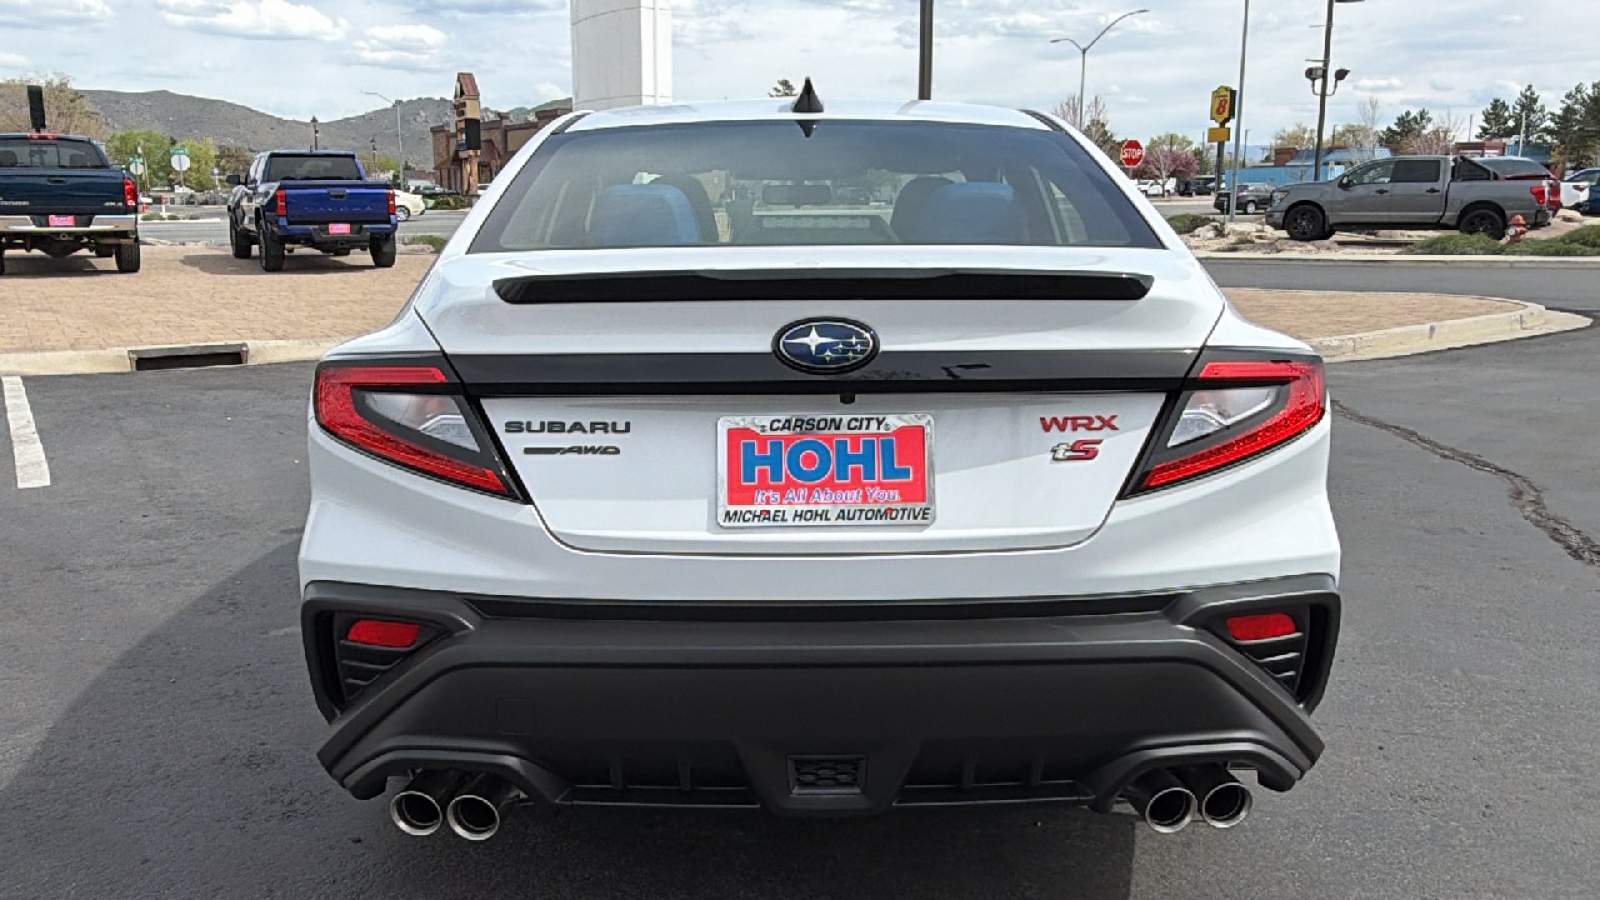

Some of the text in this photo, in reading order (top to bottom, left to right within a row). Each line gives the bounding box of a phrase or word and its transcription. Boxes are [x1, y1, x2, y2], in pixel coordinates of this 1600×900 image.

[1122, 148, 1143, 160] STOP
[504, 421, 631, 434] SUBARU
[769, 417, 886, 432] CARSON CITY
[1039, 415, 1120, 433] WRX
[741, 437, 913, 485] HOHL
[754, 489, 781, 504] It's
[784, 489, 807, 503] All
[810, 488, 863, 503] About
[723, 507, 931, 524] MICHAEL HOHL AUTOMOTIVE
